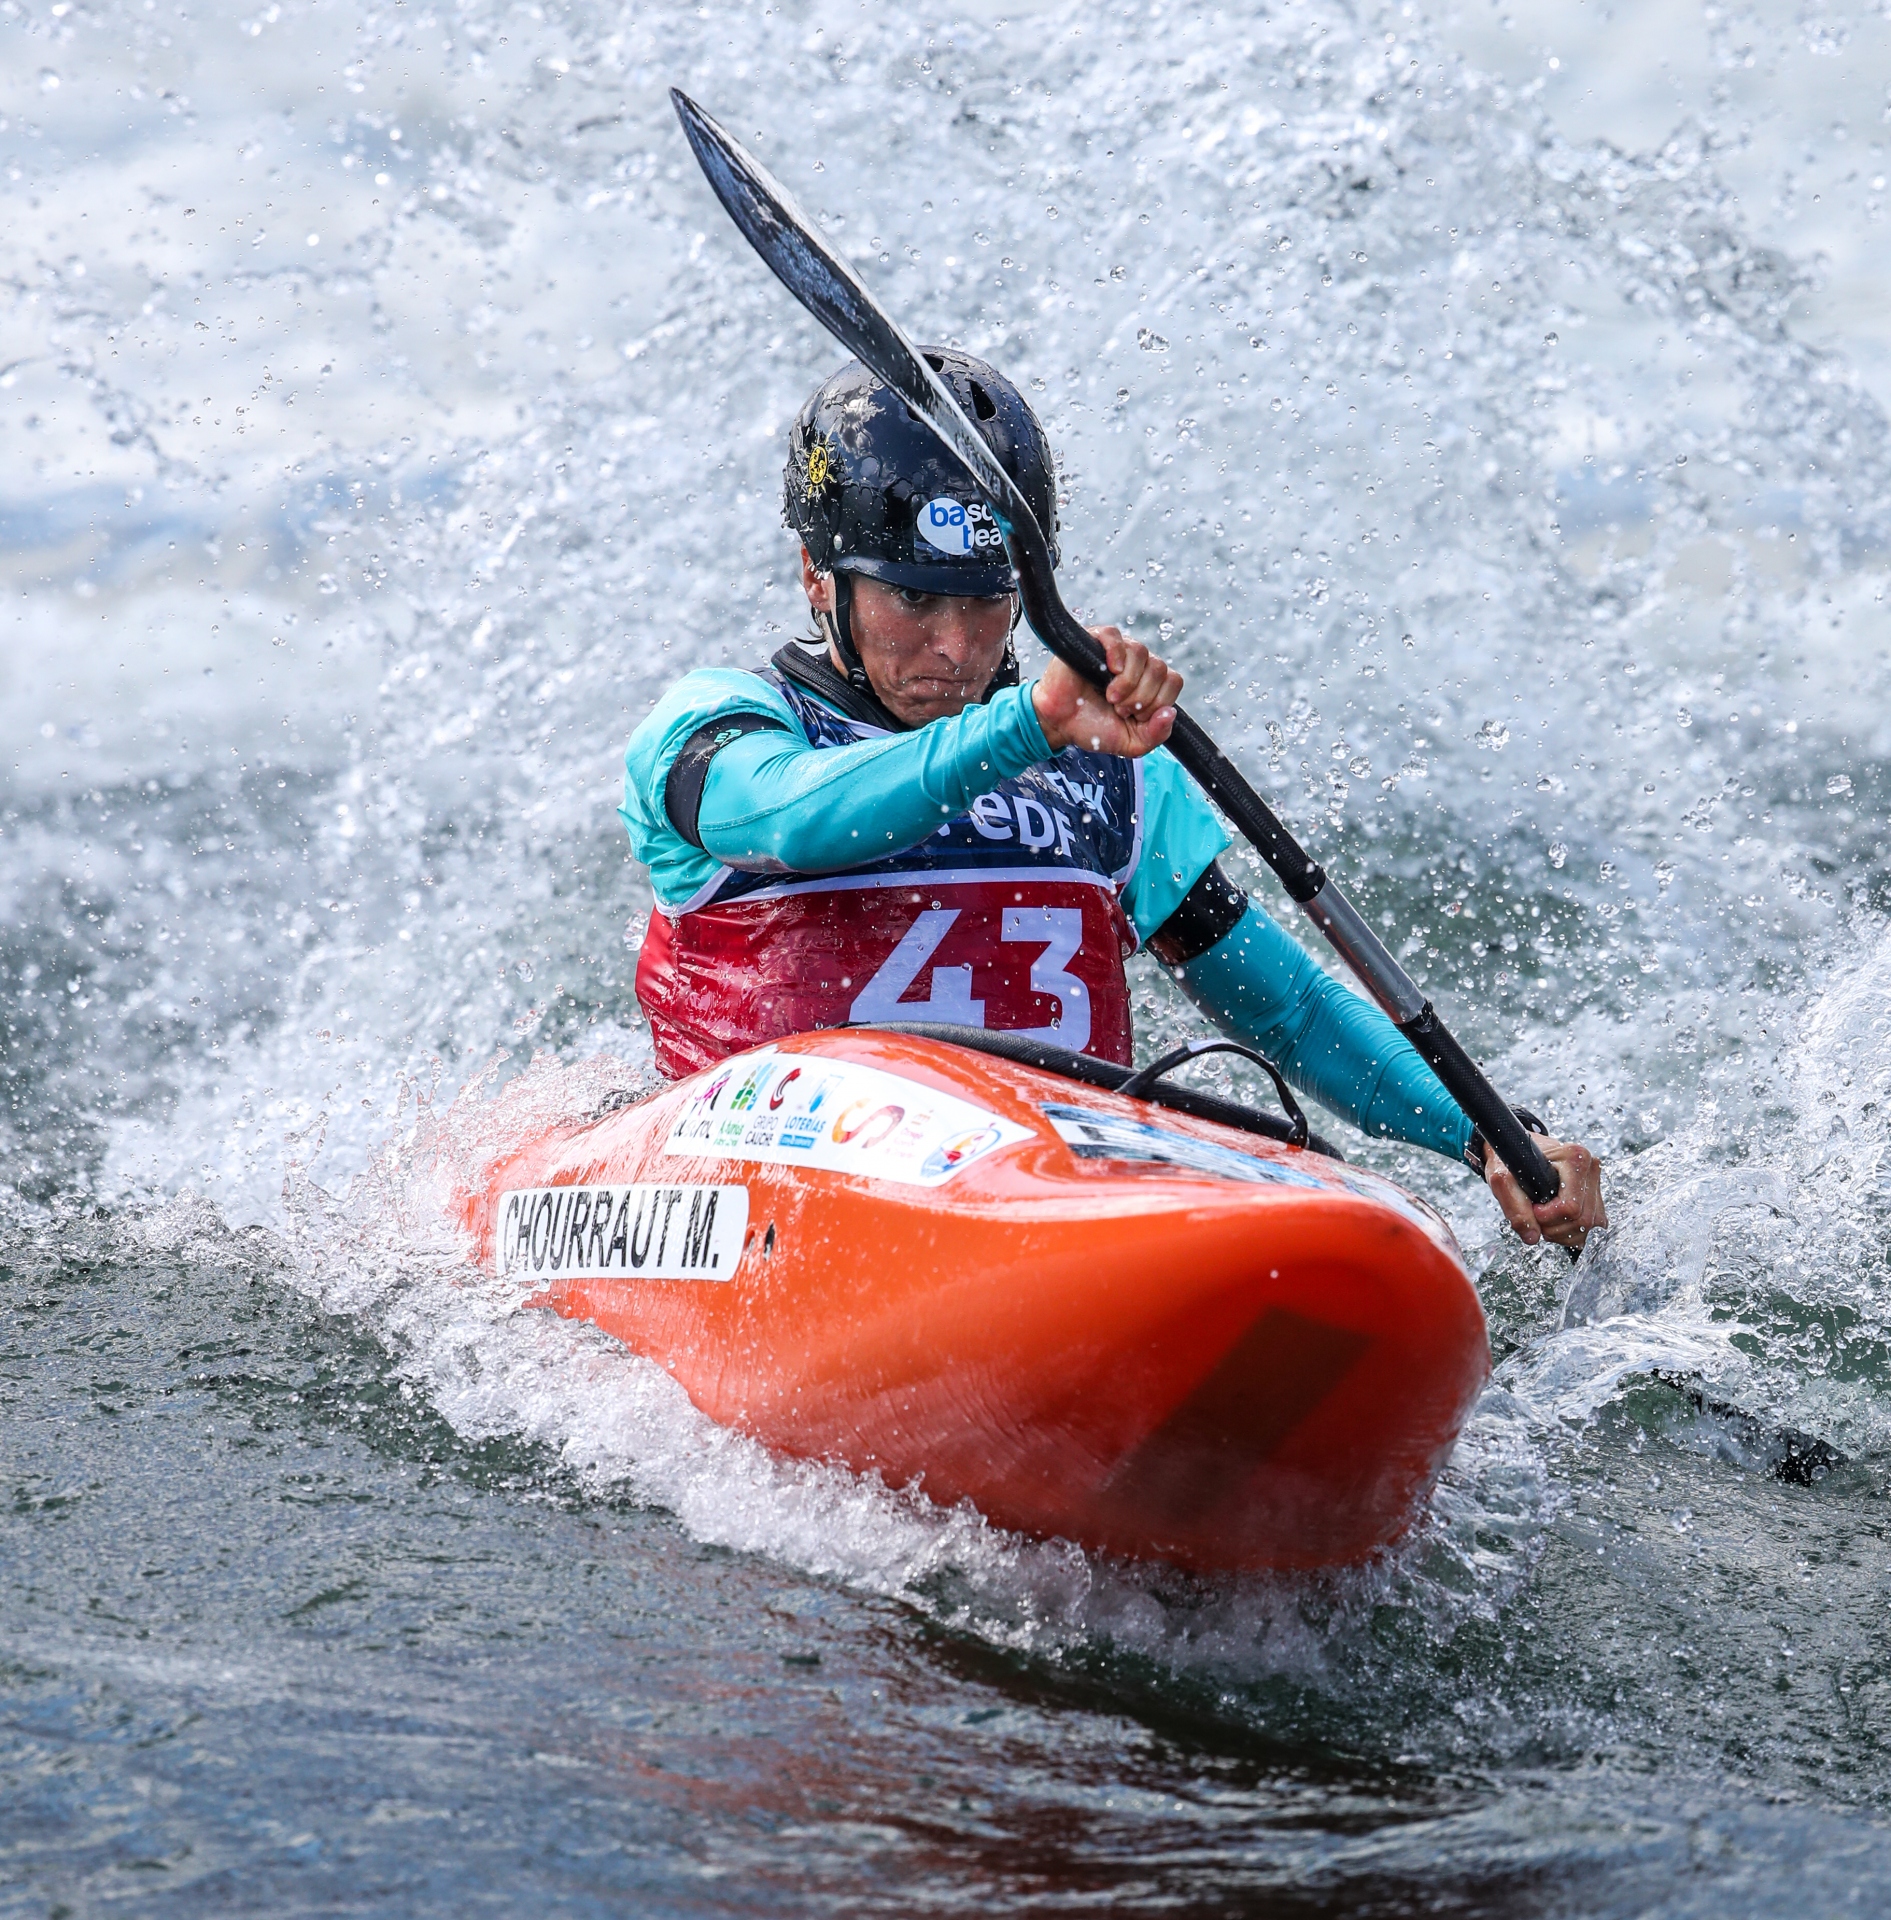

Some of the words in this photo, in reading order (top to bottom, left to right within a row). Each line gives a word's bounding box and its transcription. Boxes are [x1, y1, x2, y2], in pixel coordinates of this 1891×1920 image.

[849, 907, 1092, 1053] 43
[784, 1115, 827, 1133] LOTERÍAS
[503, 1190, 683, 1271] CHOURRAUT
[681, 1190, 719, 1269] M.
